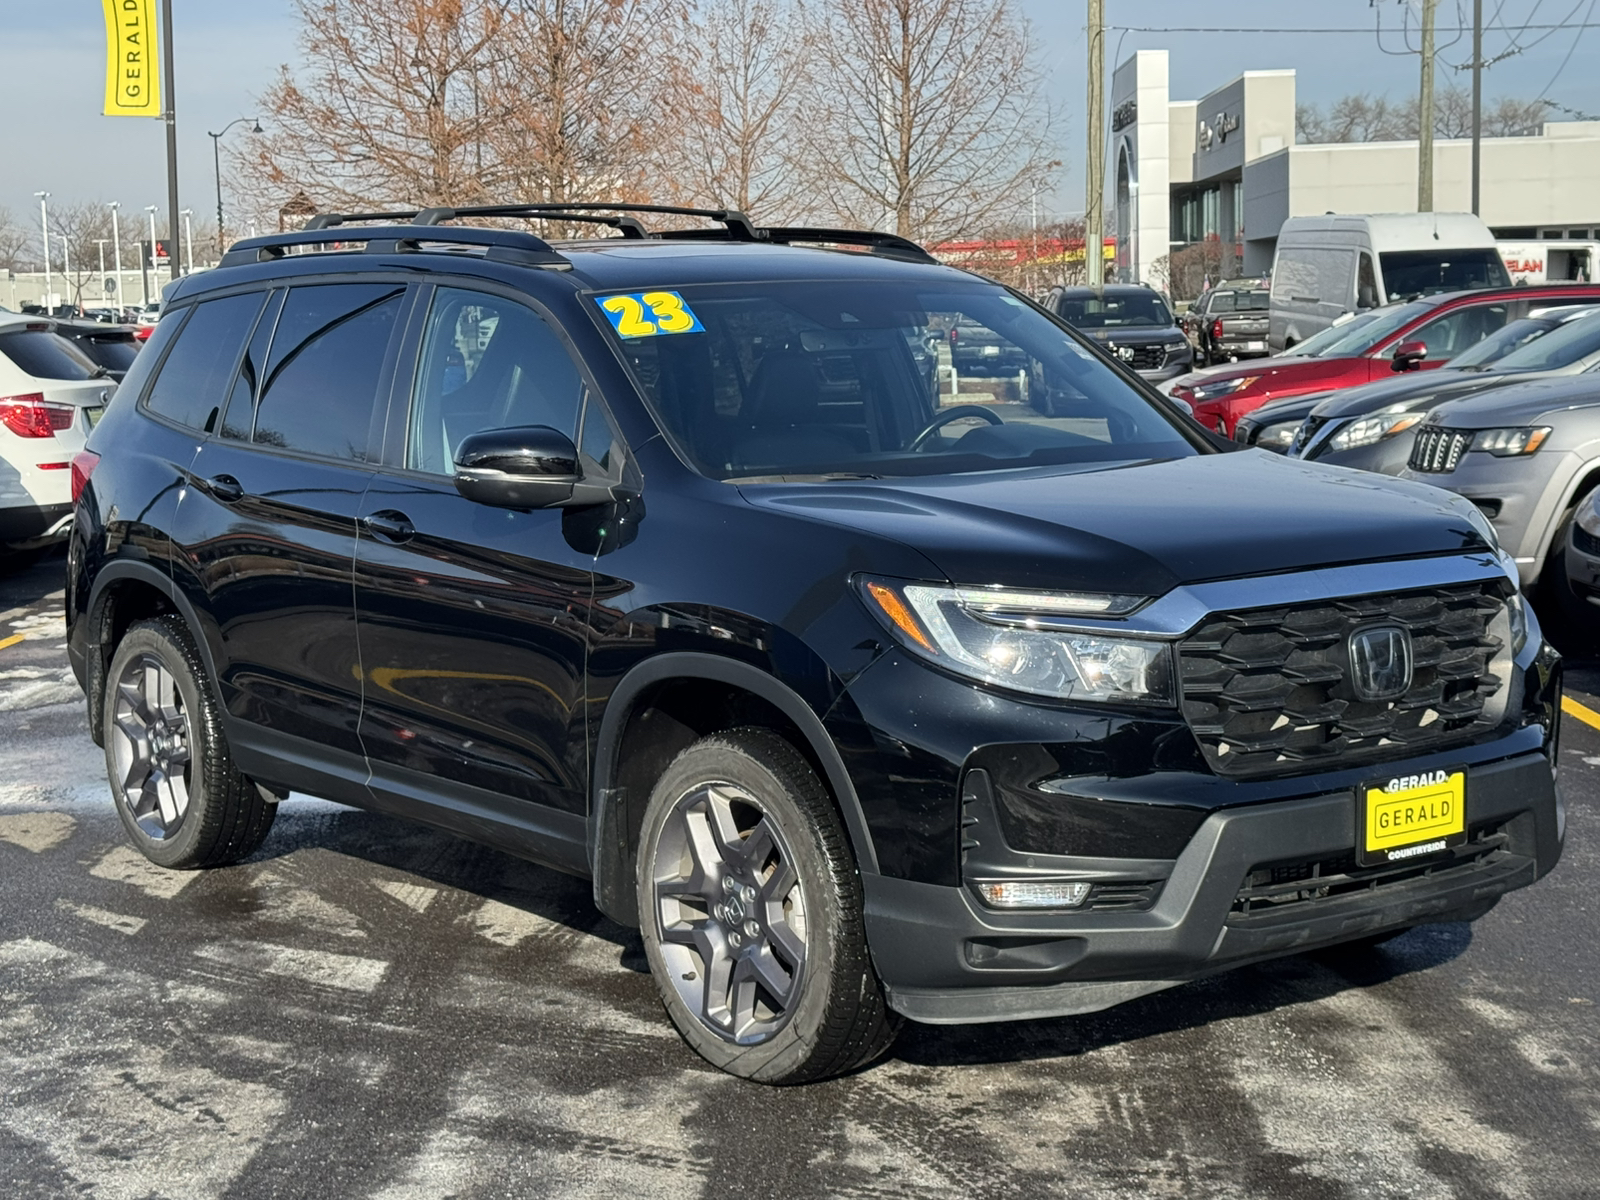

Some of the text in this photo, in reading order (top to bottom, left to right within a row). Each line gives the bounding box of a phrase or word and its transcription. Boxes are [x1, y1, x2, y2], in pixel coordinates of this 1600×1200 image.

[123, 0, 141, 97] GERALD
[603, 290, 694, 336] 23
[1387, 770, 1447, 793] GERALD
[1379, 801, 1450, 829] GERALD
[1387, 840, 1447, 861] COUNTRYSIDE
